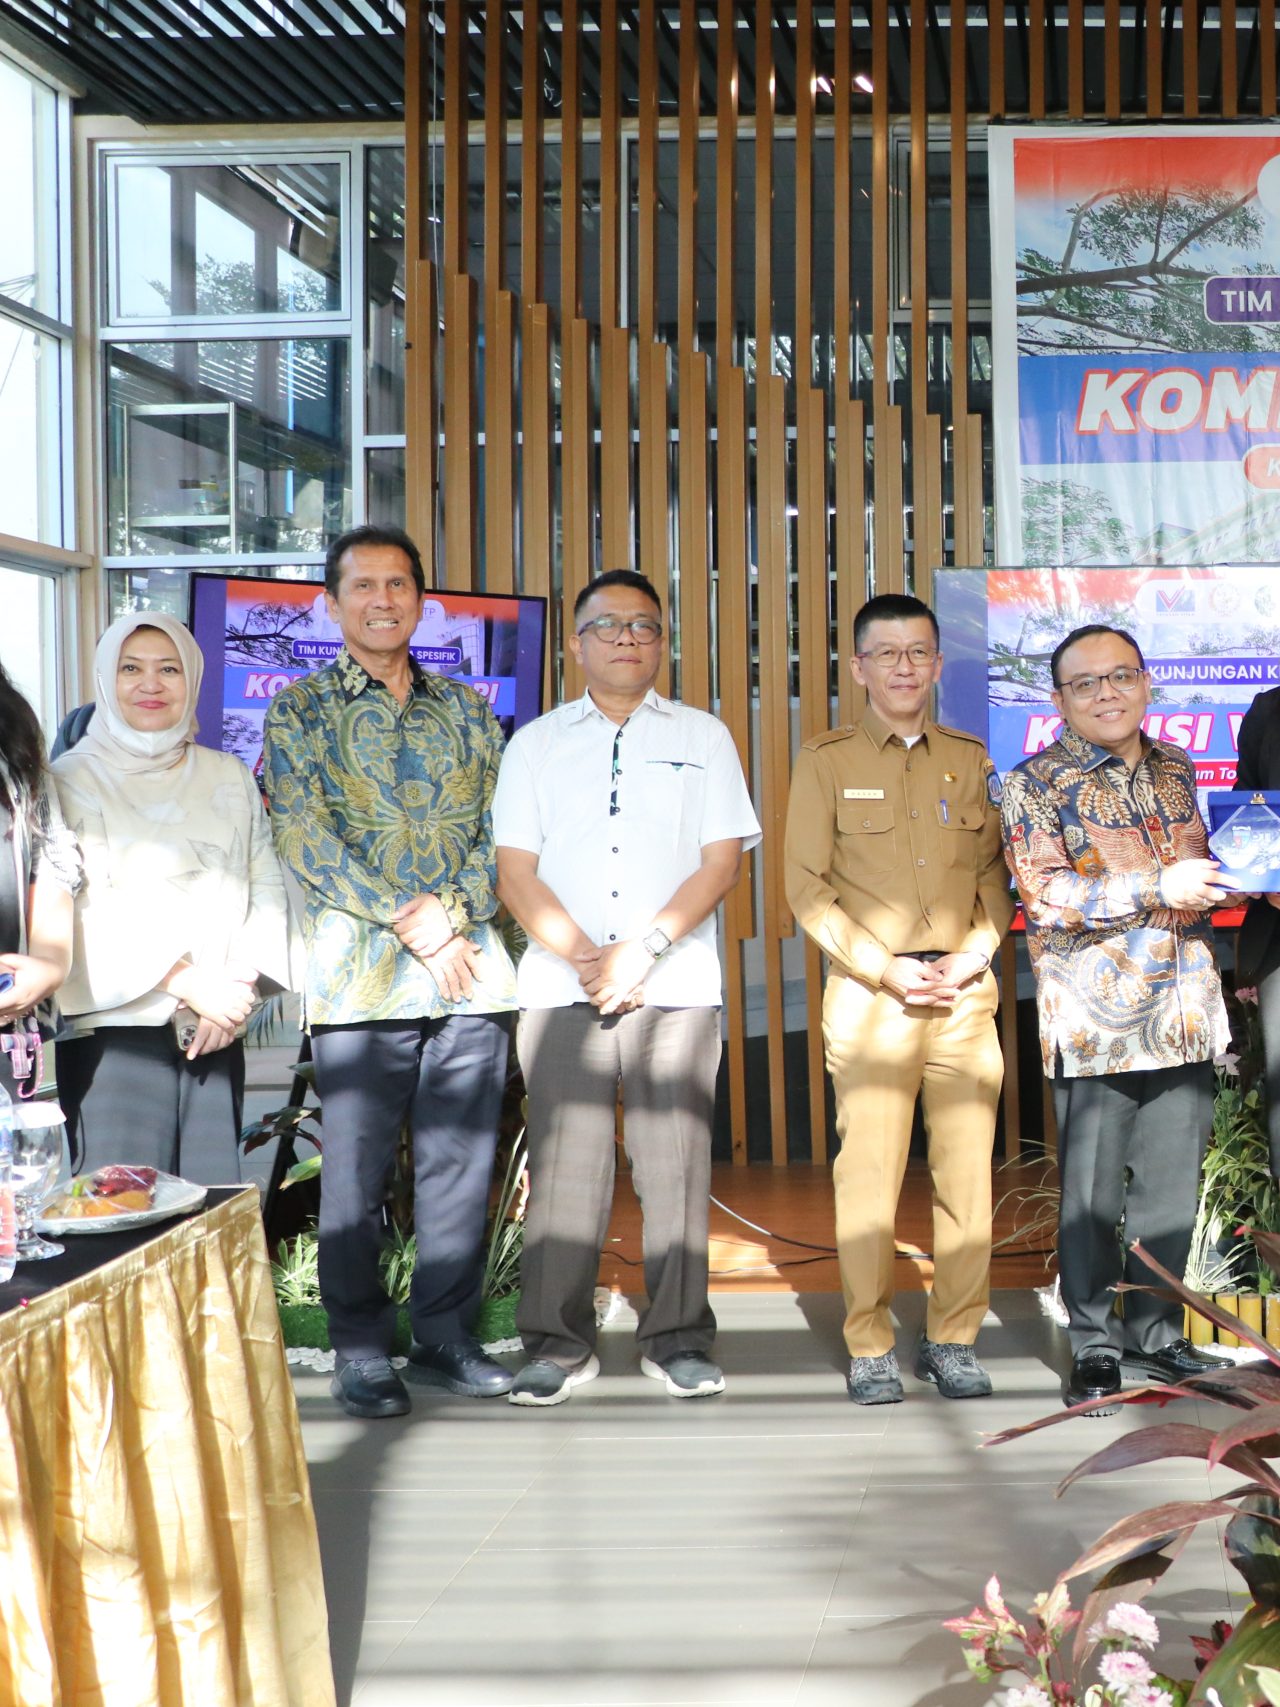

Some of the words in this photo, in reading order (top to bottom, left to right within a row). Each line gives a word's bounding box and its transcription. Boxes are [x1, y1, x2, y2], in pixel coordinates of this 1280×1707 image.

[1221, 290, 1272, 312] TIM
[423, 607, 436, 616] TP
[298, 645, 316, 655] TIM
[416, 651, 457, 661] SPESIFIK
[1149, 664, 1263, 680] KUNJUNGAN
